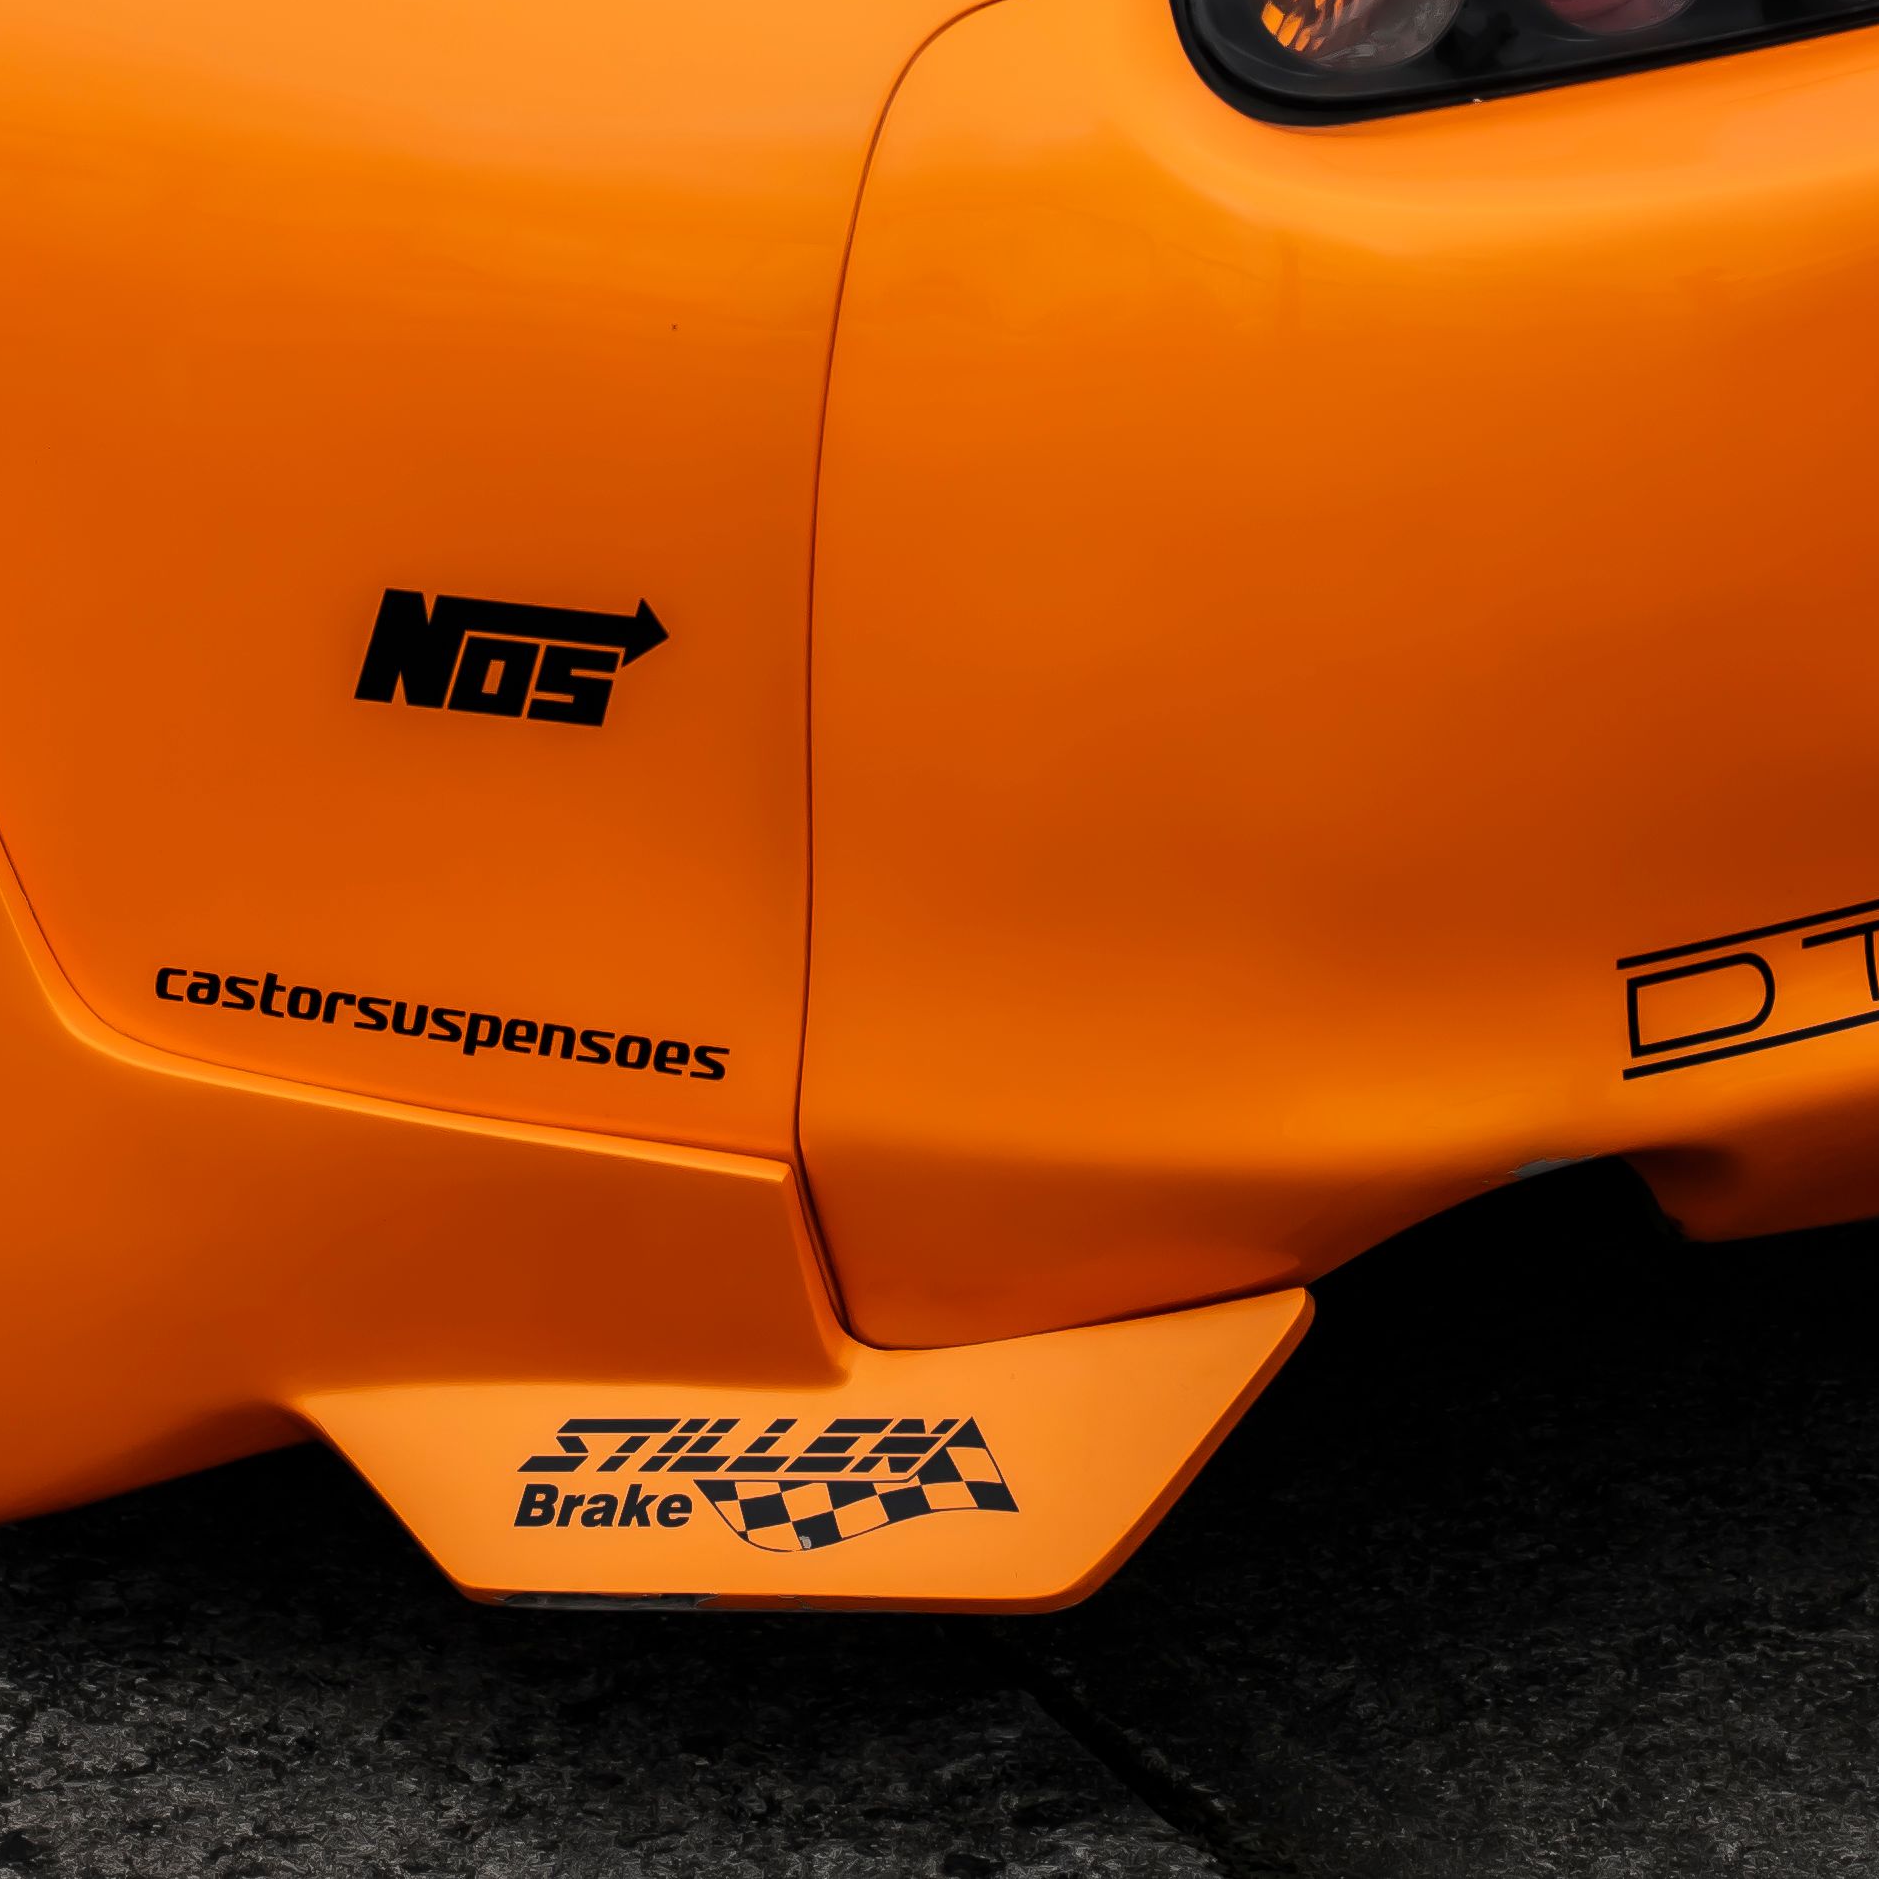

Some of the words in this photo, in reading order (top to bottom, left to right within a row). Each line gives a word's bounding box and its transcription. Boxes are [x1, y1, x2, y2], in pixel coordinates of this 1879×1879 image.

[353, 587, 670, 728] NOS
[154, 966, 731, 1081] castorsuspensoes
[516, 1417, 961, 1474] STILLEN
[513, 1482, 694, 1528] Brake
